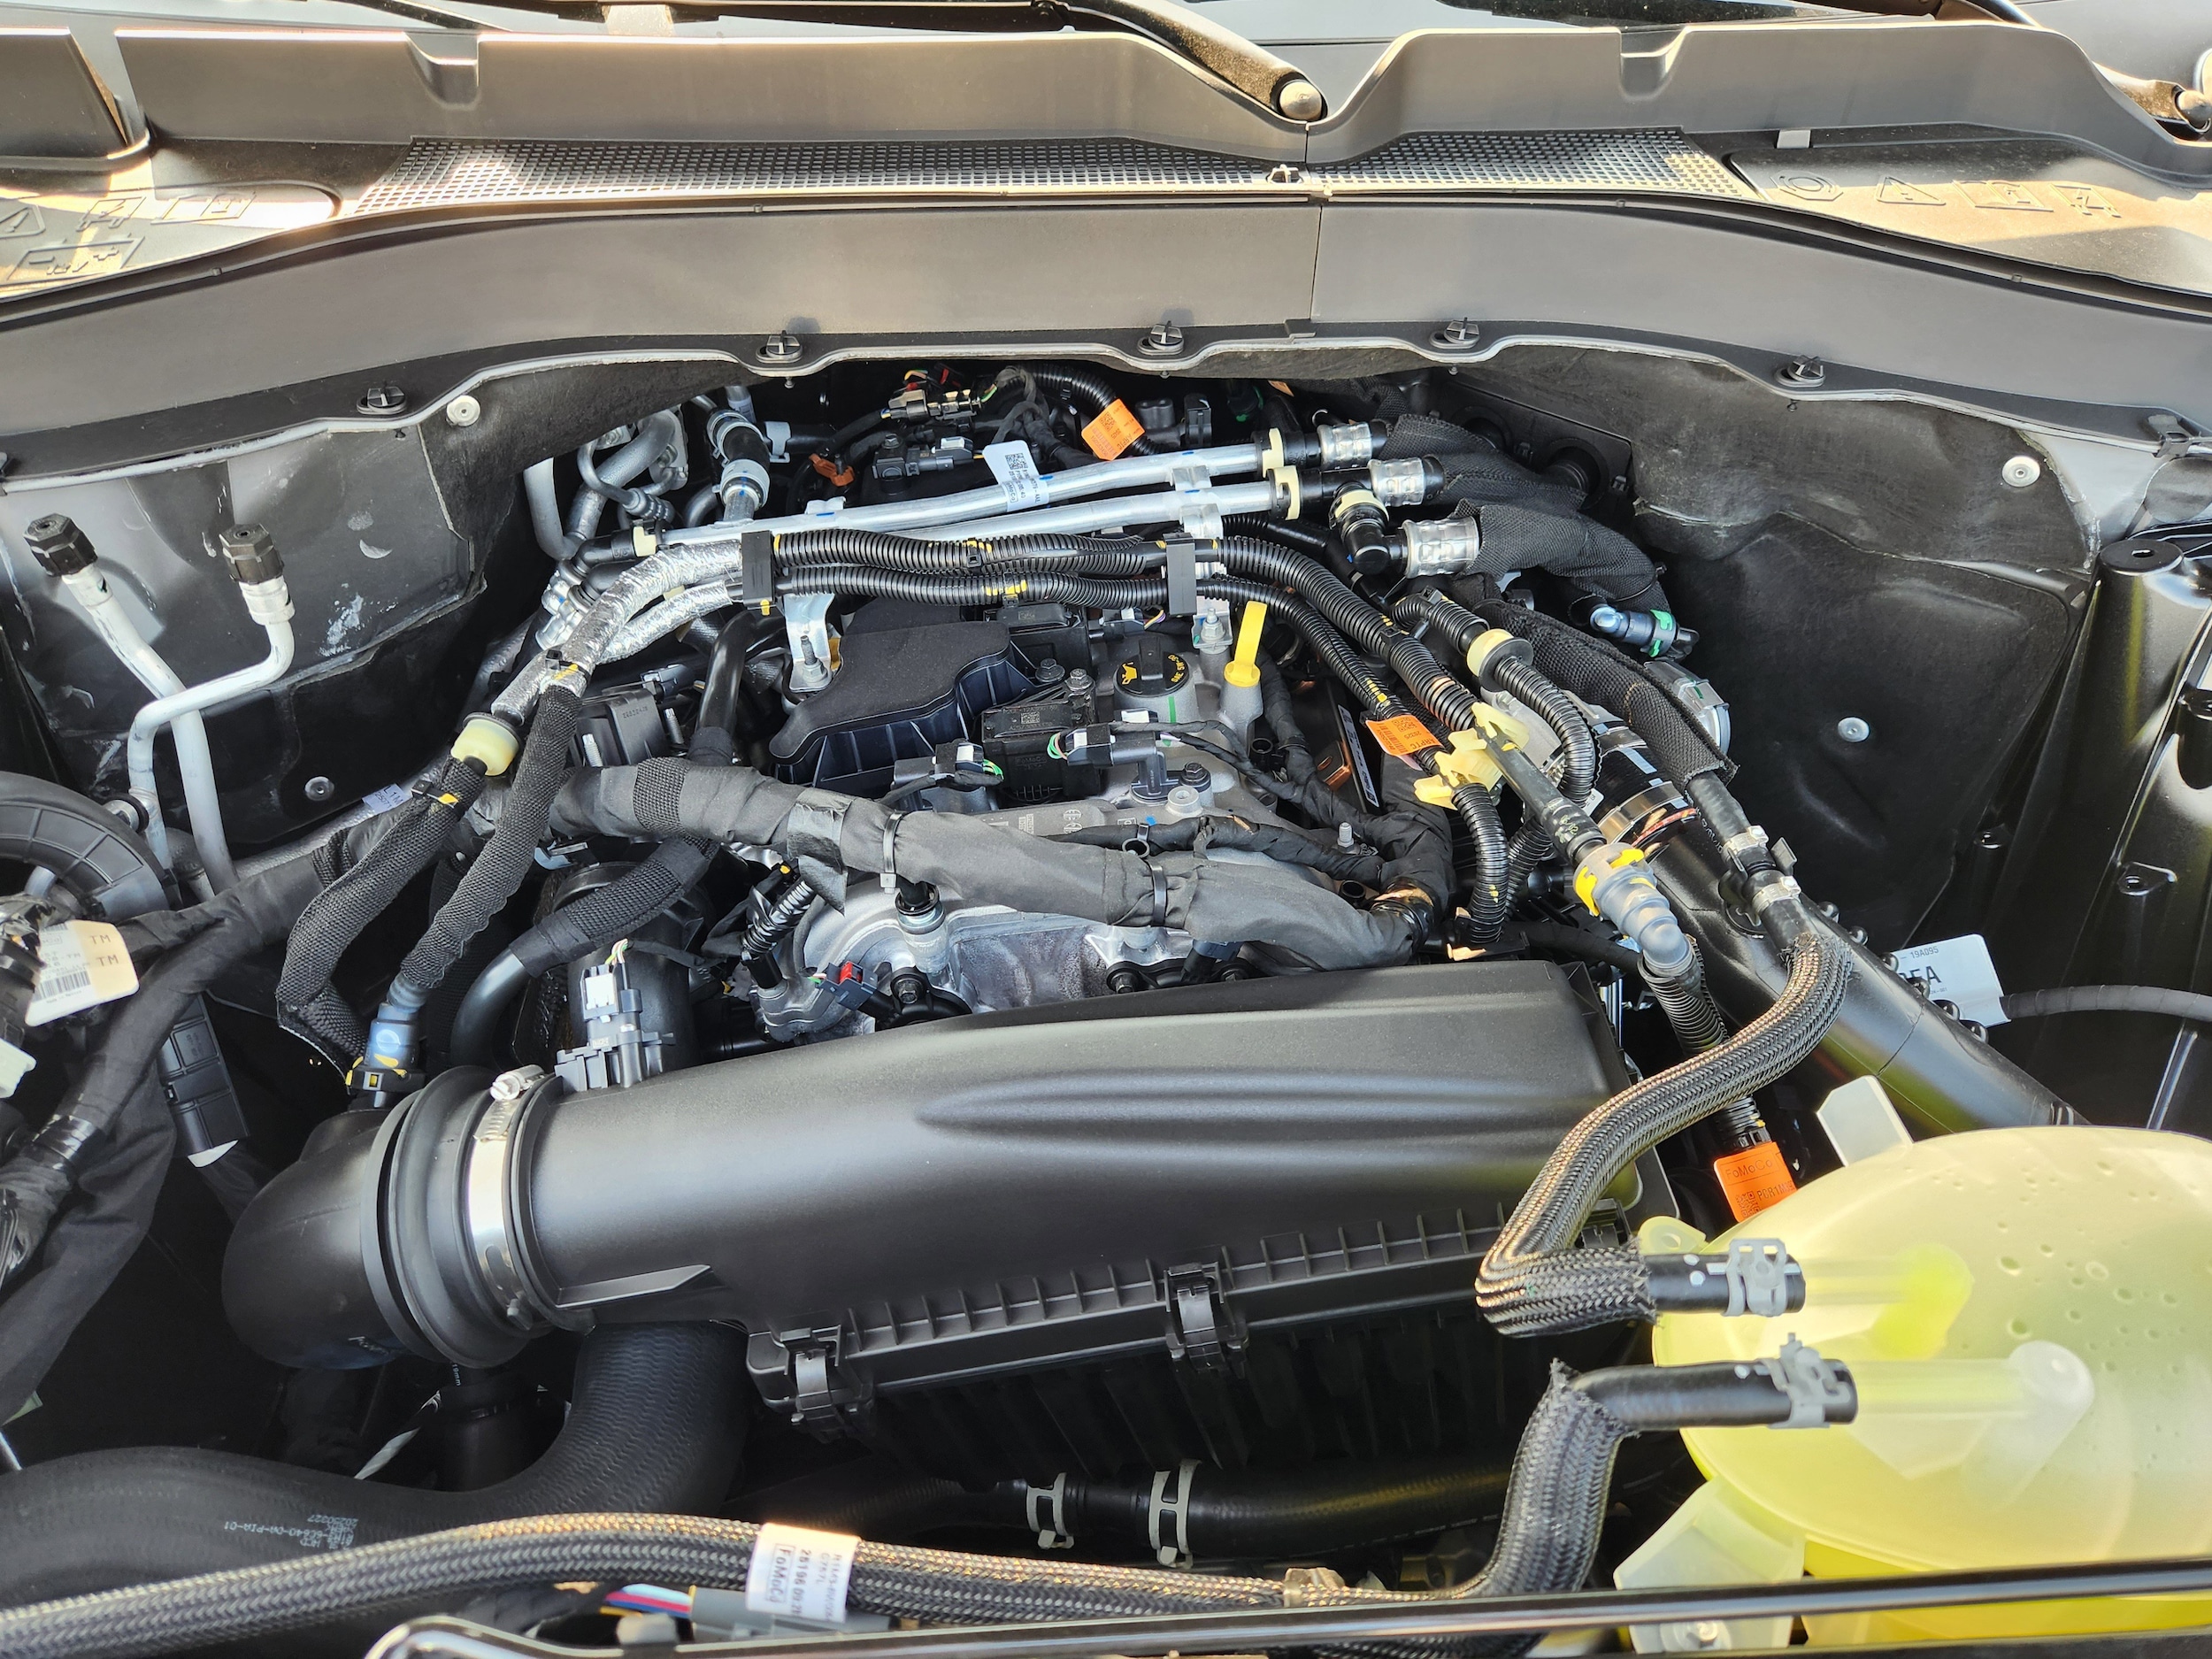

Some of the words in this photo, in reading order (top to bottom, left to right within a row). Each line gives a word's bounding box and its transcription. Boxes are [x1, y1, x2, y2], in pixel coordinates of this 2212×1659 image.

[1409, 738, 1436, 749] ARPTC
[383, 785, 403, 805] L1M
[90, 934, 111, 944] TM
[1910, 946, 1939, 959] 19A095
[96, 955, 119, 966] TM
[1724, 1159, 1774, 1180] FoMoCo
[771, 1548, 791, 1603] FoMoCo
